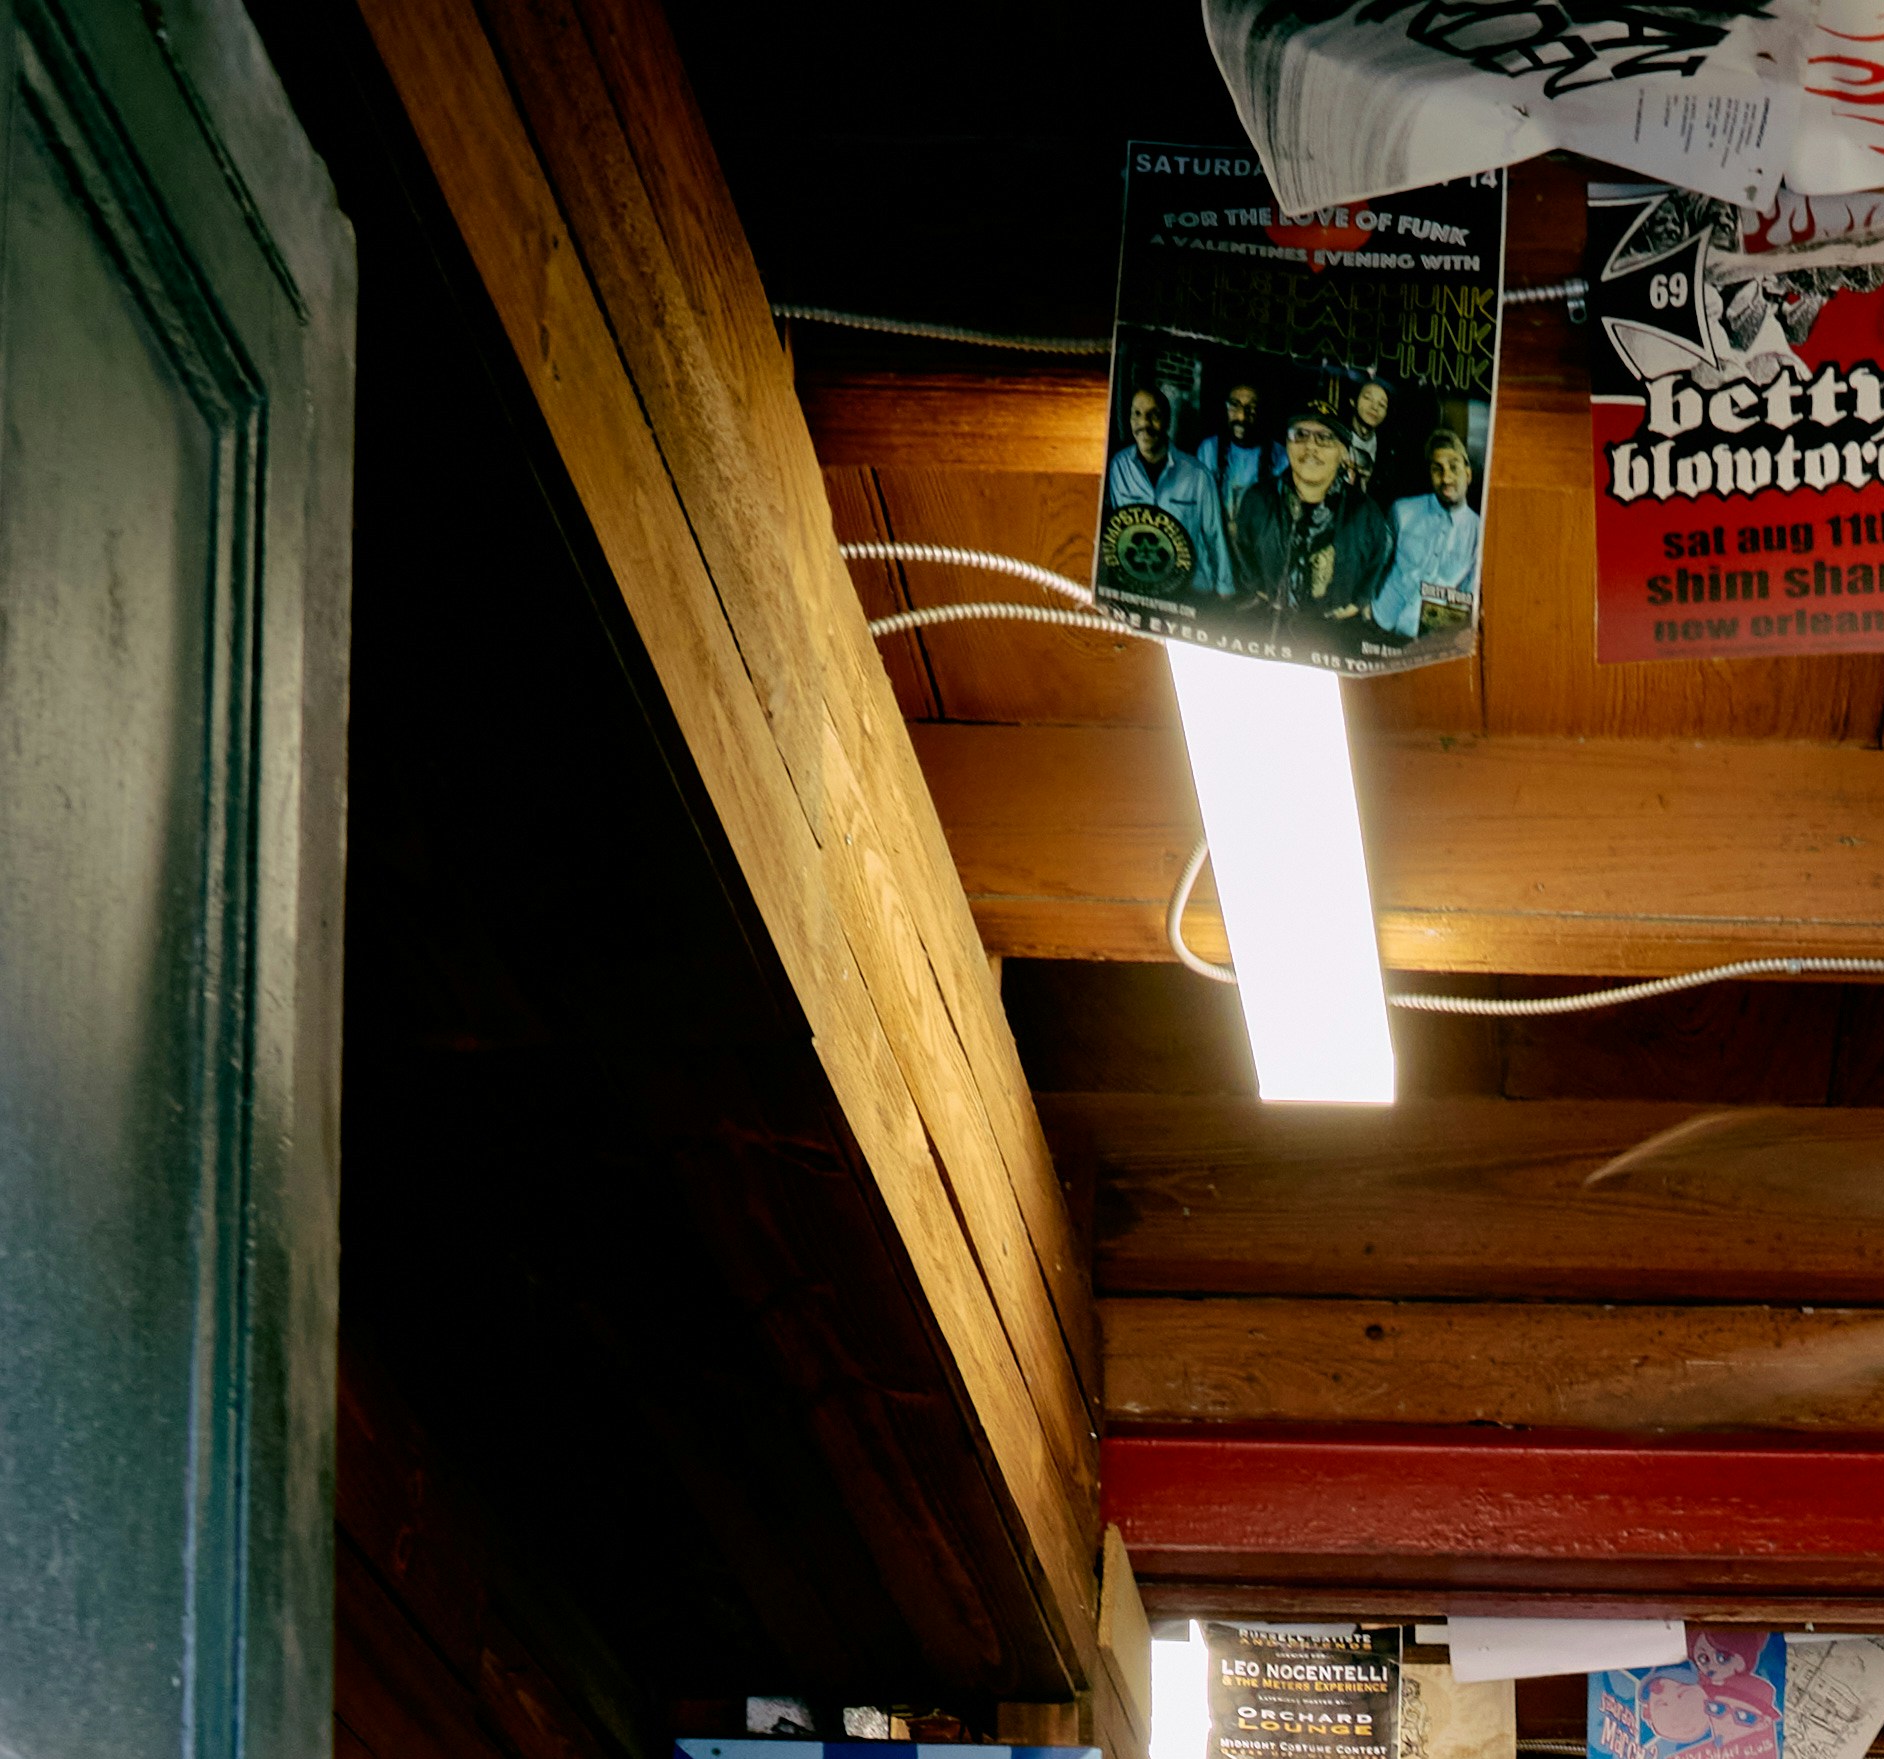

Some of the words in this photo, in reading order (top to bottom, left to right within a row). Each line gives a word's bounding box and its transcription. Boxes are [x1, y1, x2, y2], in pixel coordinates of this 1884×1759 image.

[1650, 272, 1689, 309] 69
[1662, 526, 1726, 560] sat
[1737, 522, 1814, 555] aug
[1646, 566, 1770, 606] shim
[1654, 618, 1739, 643] new
[1221, 1658, 1260, 1677] LEO
[1266, 1662, 1388, 1682] NOCENTELLI
